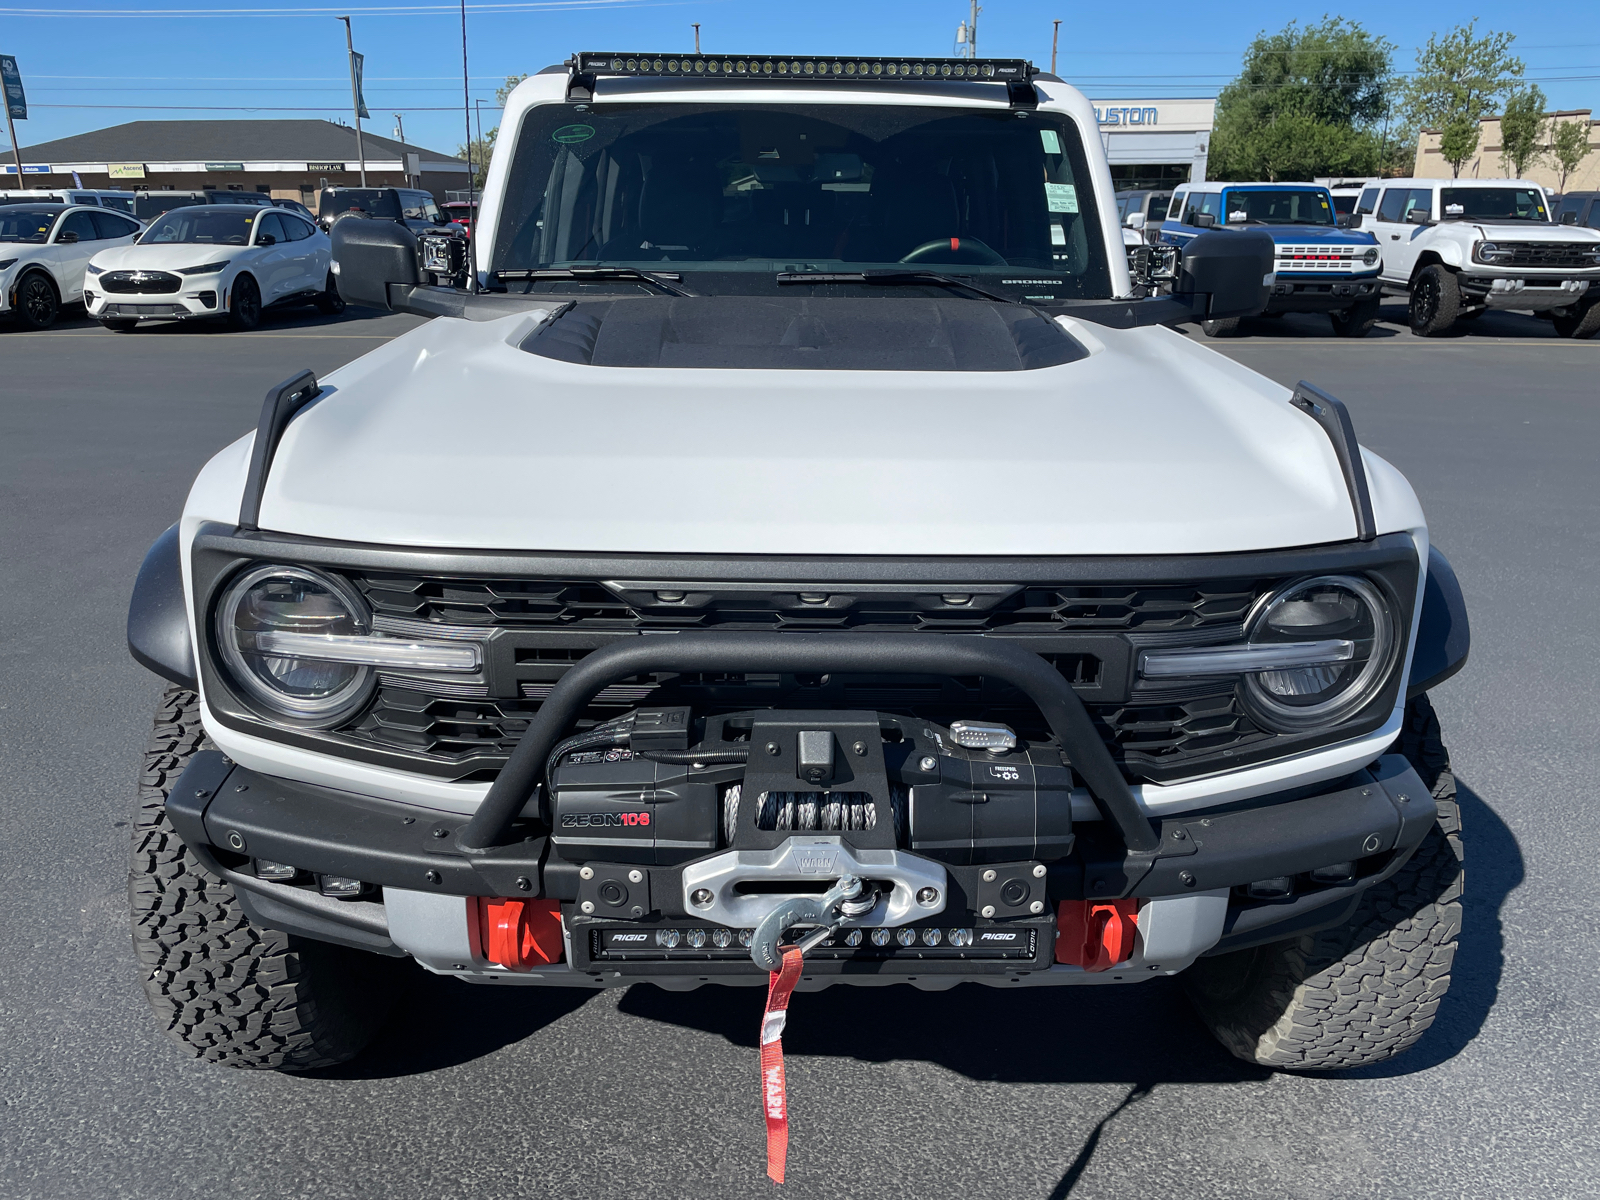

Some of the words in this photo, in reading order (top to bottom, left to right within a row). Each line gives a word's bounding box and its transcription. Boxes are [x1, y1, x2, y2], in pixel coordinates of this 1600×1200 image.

[800, 857, 831, 868] WARN
[611, 933, 648, 942] RIGID
[981, 932, 1017, 941] RIGID
[766, 1065, 783, 1120] WARN
